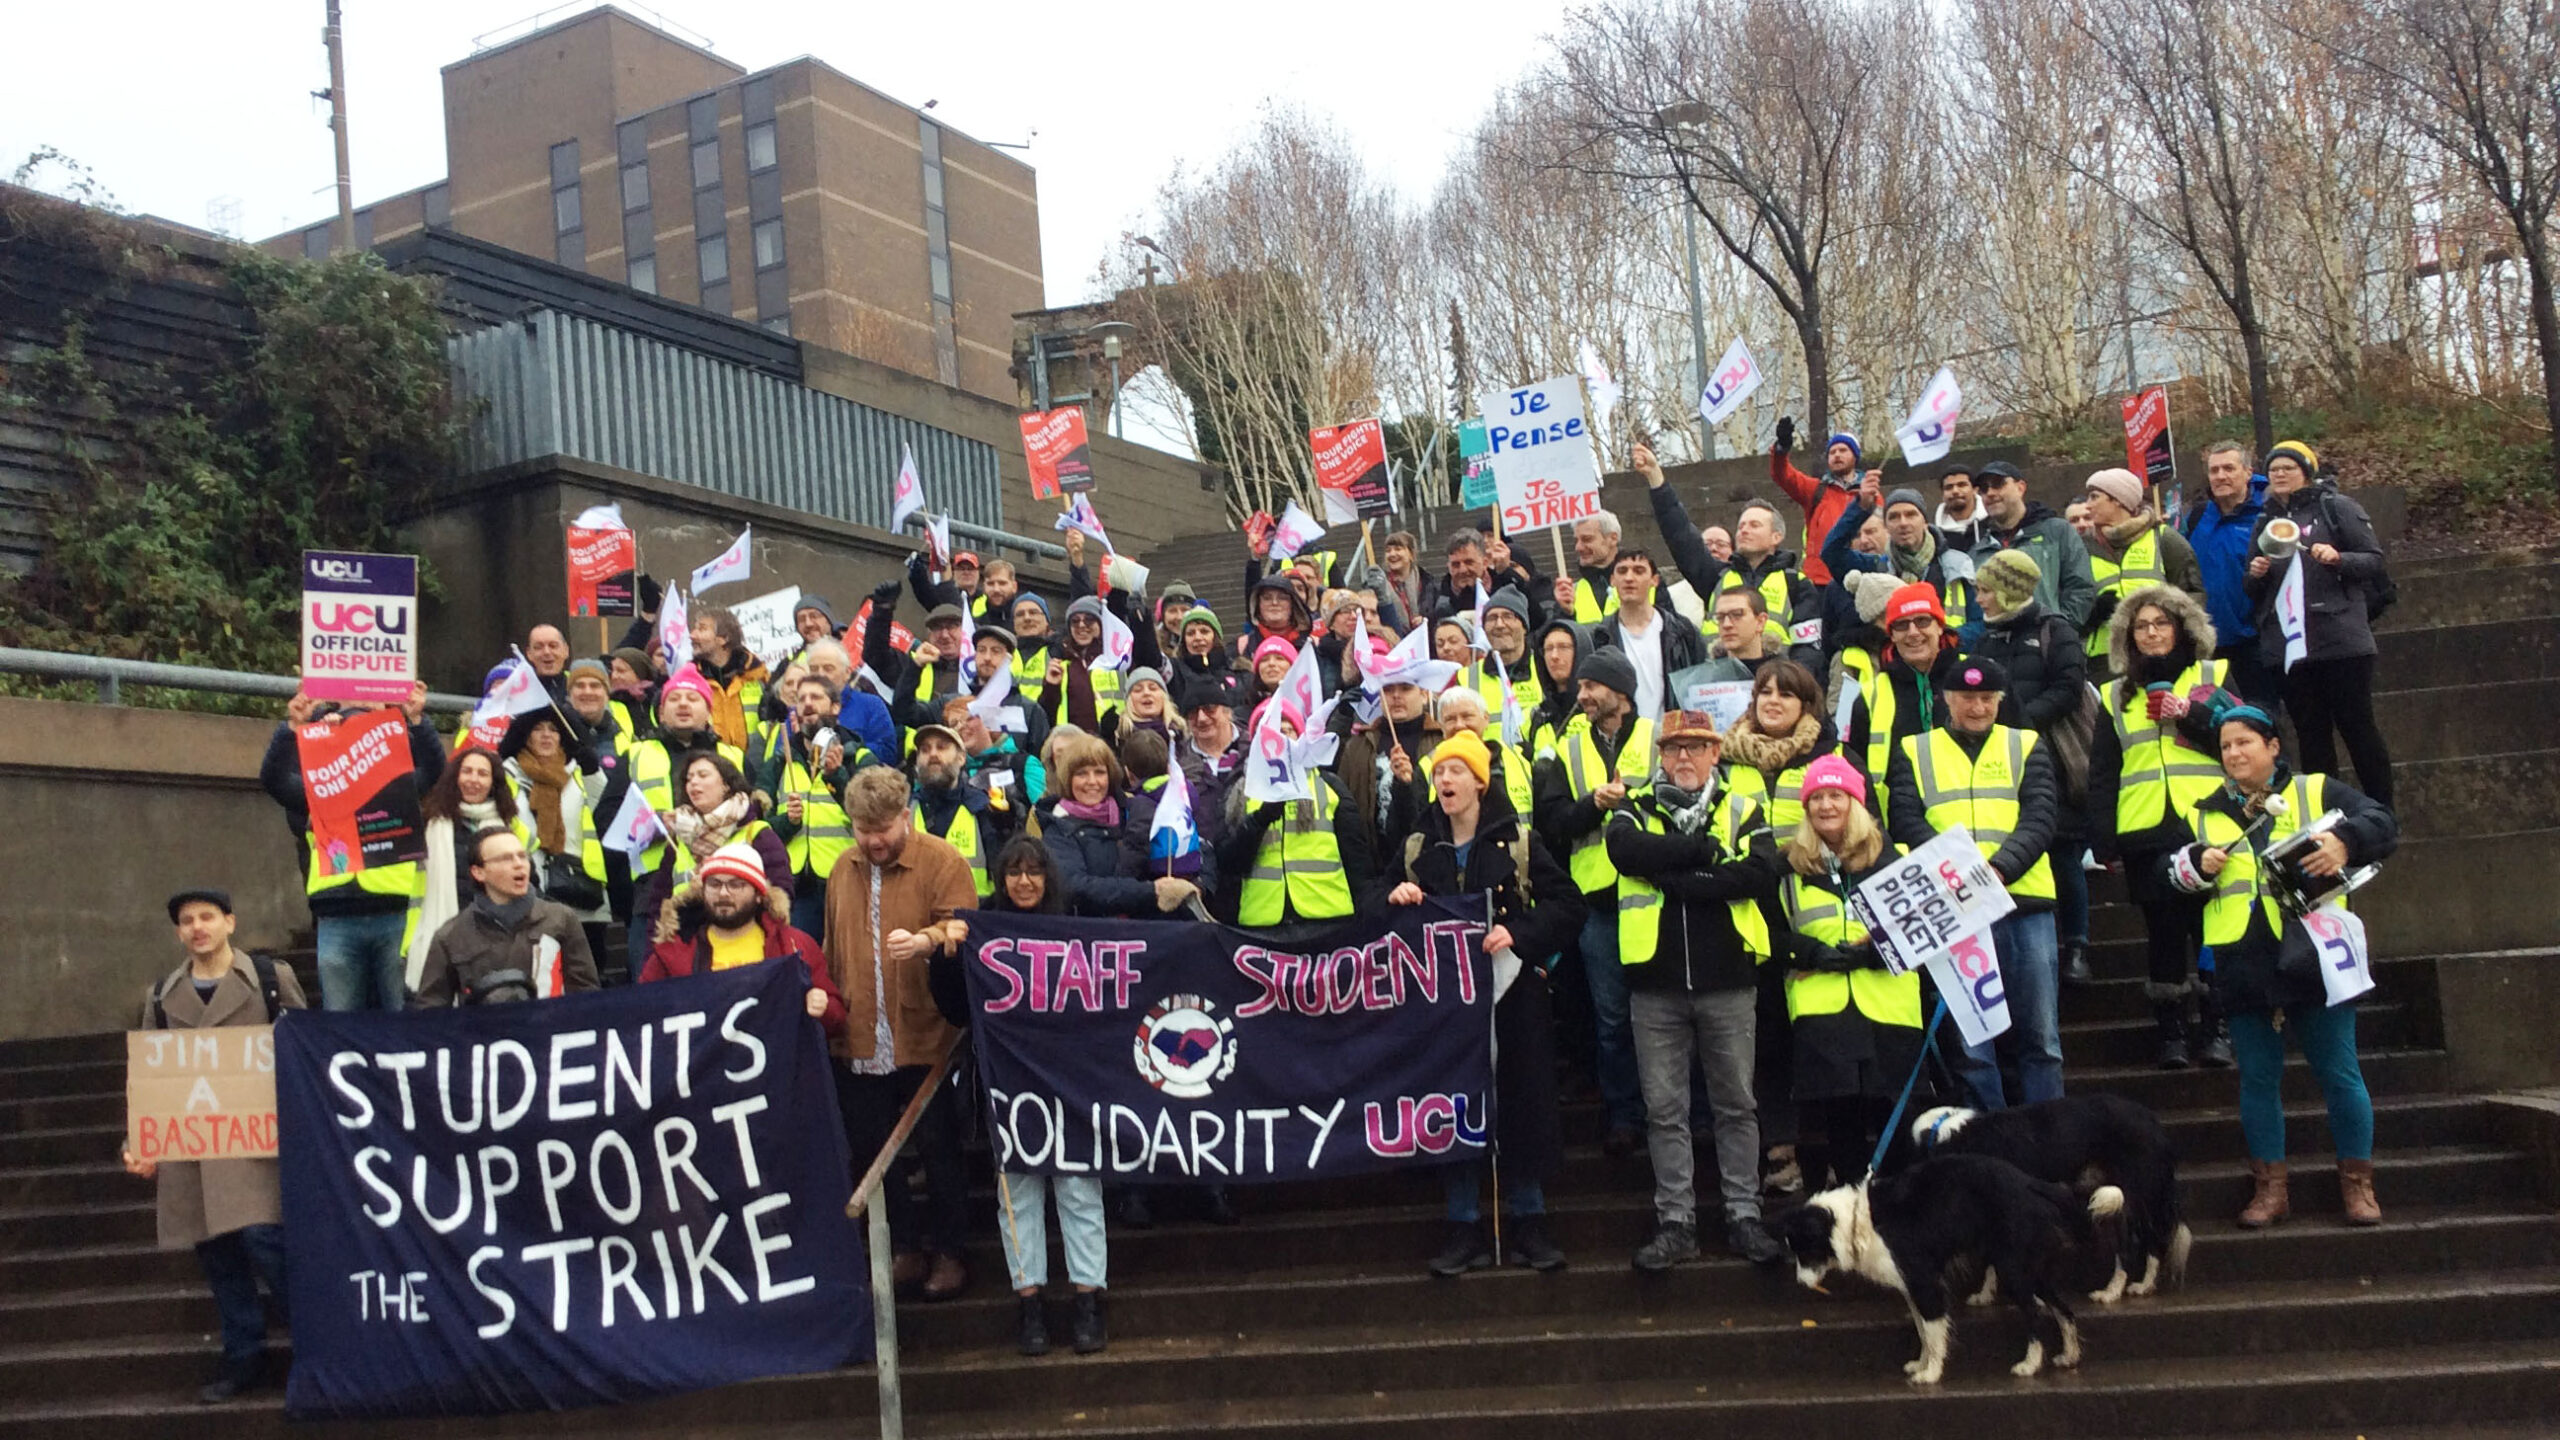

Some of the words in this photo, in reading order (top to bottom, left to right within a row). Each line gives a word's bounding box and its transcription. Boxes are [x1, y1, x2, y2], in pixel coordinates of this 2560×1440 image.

[1510, 390, 1550, 416] Je
[1315, 443, 1343, 461] FOUR
[1342, 421, 1377, 447] FIGHTS
[1319, 456, 1342, 470] ONE
[1340, 435, 1368, 459] VOICE
[1490, 418, 1583, 454] Pense
[1525, 479, 1565, 500] Je
[1505, 491, 1599, 532] STRIKE
[311, 559, 363, 578] UCU
[312, 602, 407, 635] UCU
[311, 634, 407, 653] OFFICIAL
[311, 652, 407, 673] DISPUTE
[307, 754, 350, 783] FOUR
[349, 721, 404, 760] FIGHTS
[313, 776, 349, 798] ONE
[347, 741, 392, 782] VOICE
[1939, 860, 1973, 902] UCU
[1875, 878, 1938, 955] PICKET
[1900, 864, 1962, 945] OFFICIAL
[978, 937, 1147, 1013] STAFF
[1234, 920, 1486, 1018] STUDENT
[145, 1035, 219, 1069] JIM
[244, 1034, 275, 1072] IS
[328, 997, 767, 1133] STUDENTS
[186, 1077, 219, 1112] A
[139, 1113, 279, 1158] BASTARD
[1364, 1092, 1486, 1158] UCU
[353, 1095, 768, 1235] SUPPORT
[350, 1270, 429, 1323] THE
[468, 1193, 815, 1340] STRIKE
